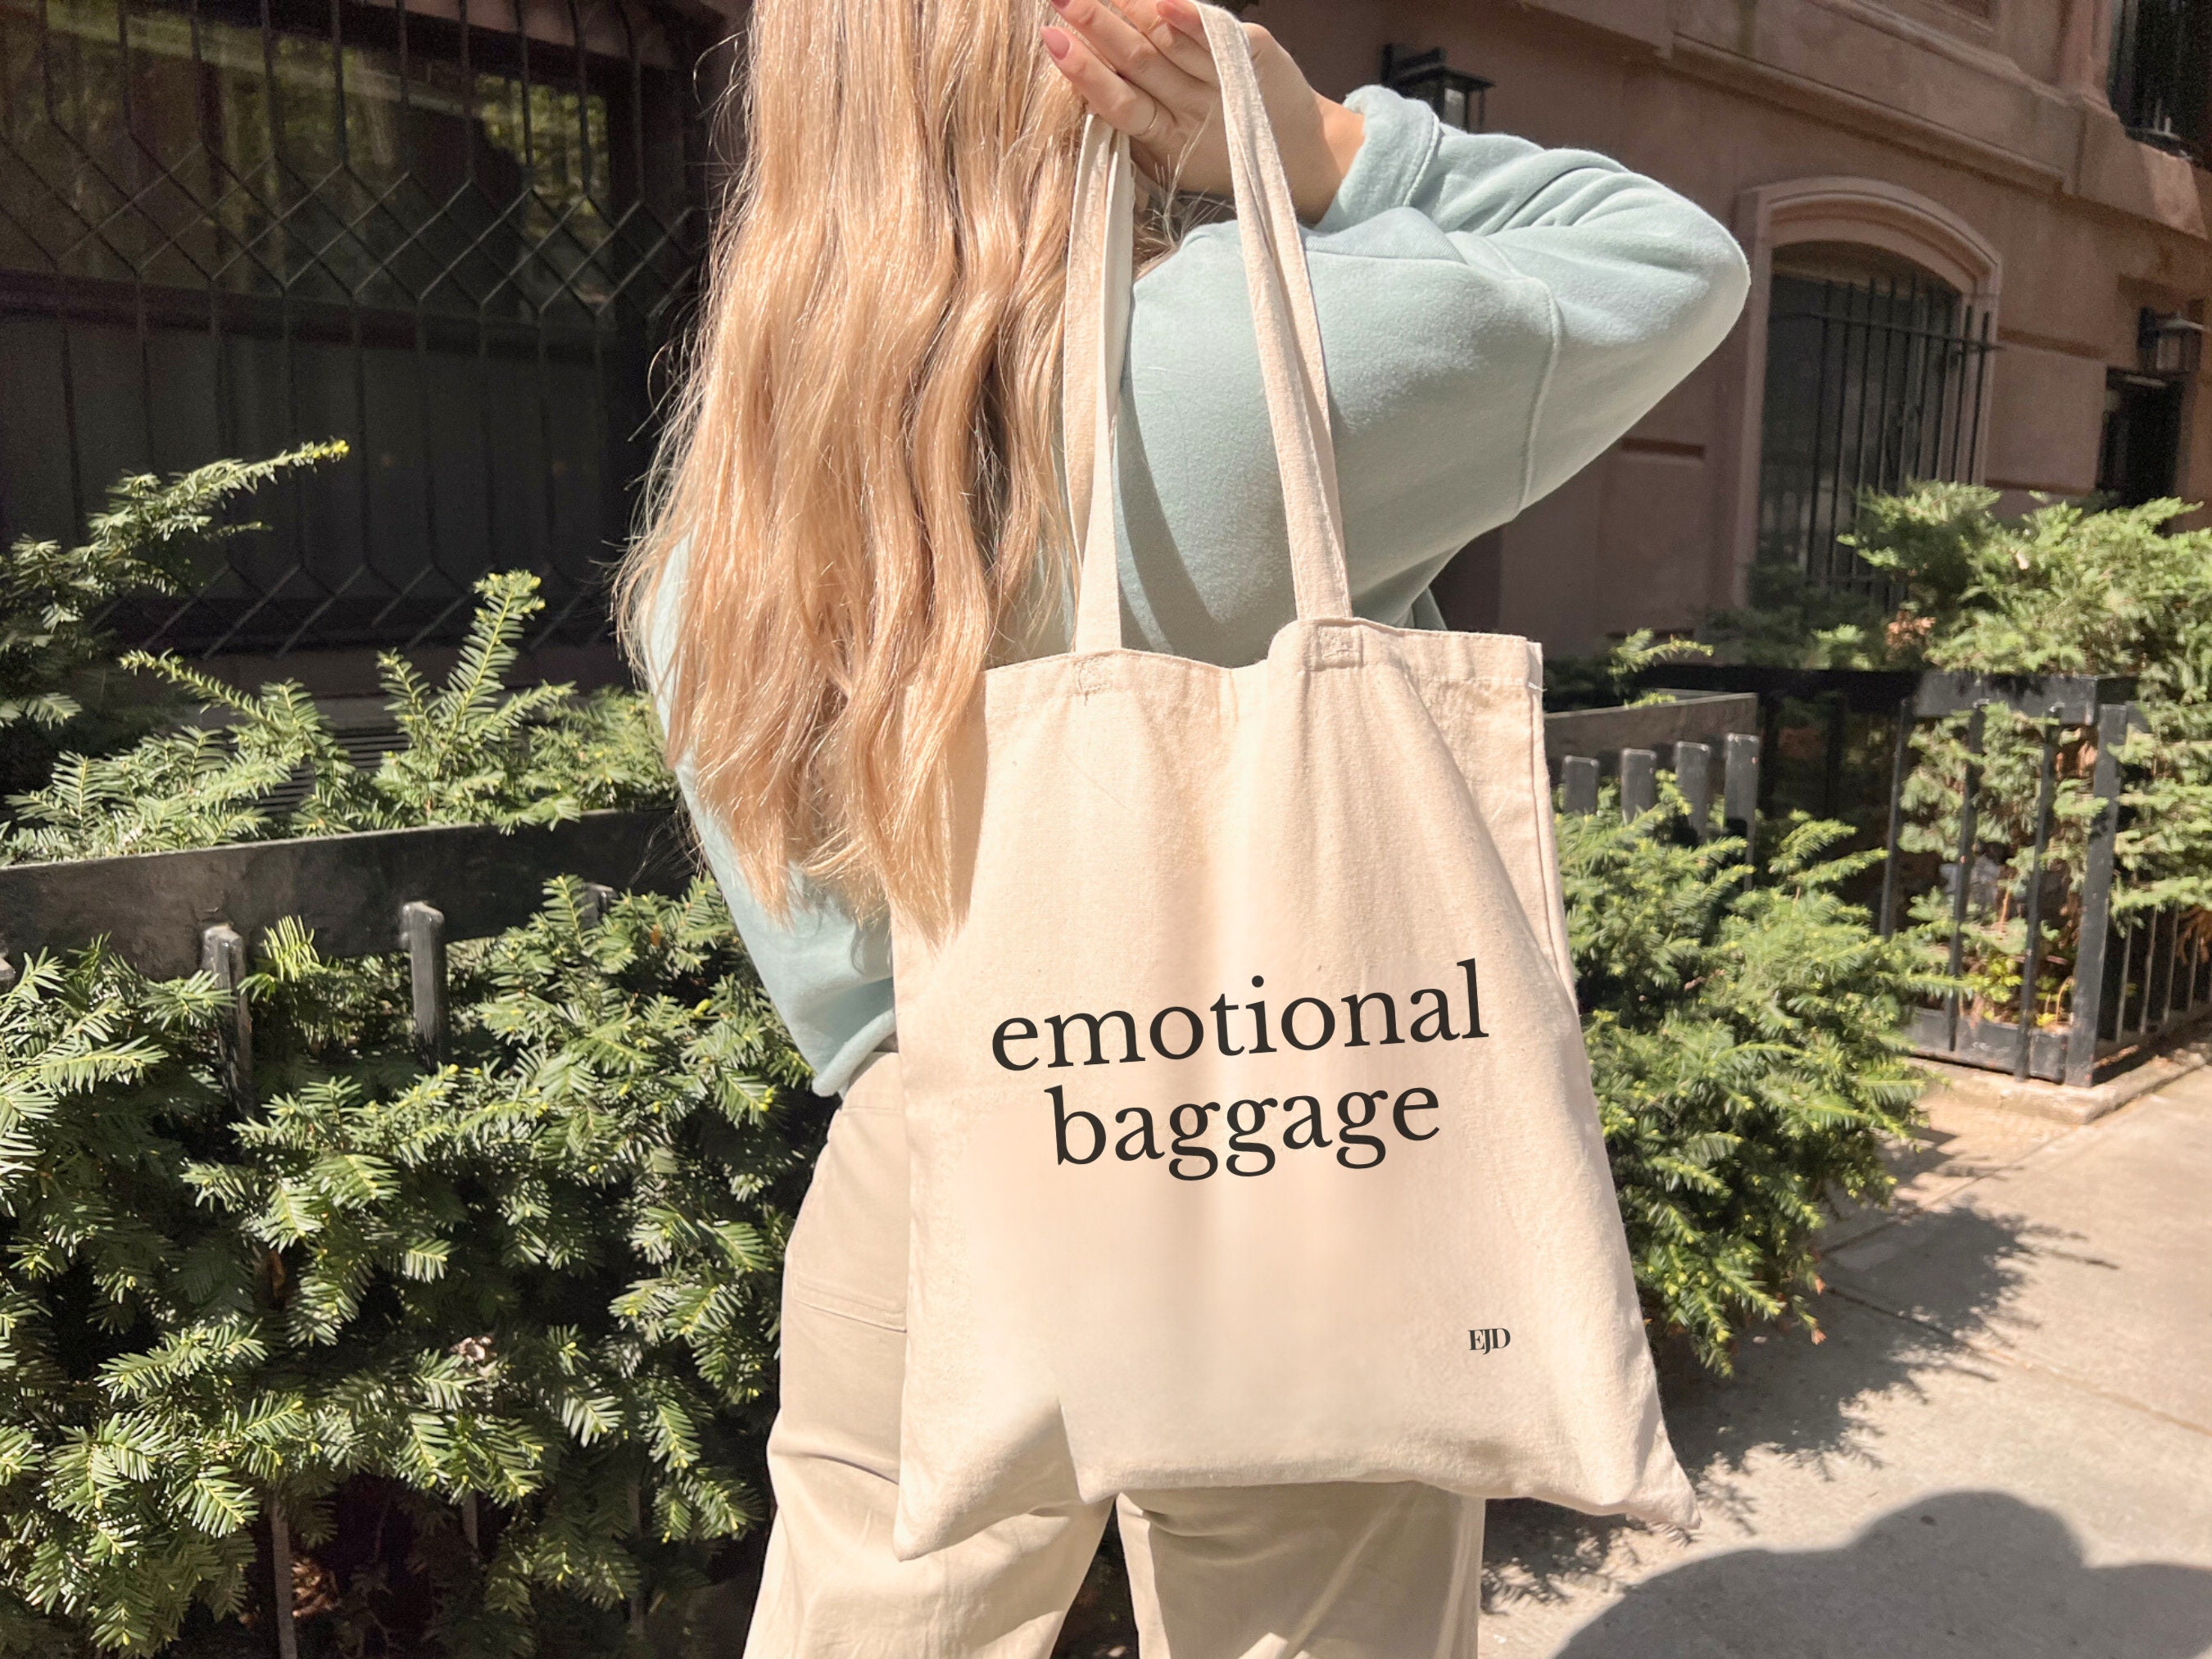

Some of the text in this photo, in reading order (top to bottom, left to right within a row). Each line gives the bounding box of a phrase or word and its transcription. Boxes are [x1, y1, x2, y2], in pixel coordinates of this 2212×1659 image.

[992, 958, 1489, 1072] emotional
[1044, 1084, 1440, 1181] baggage
[1467, 1327, 1512, 1355] EJD
